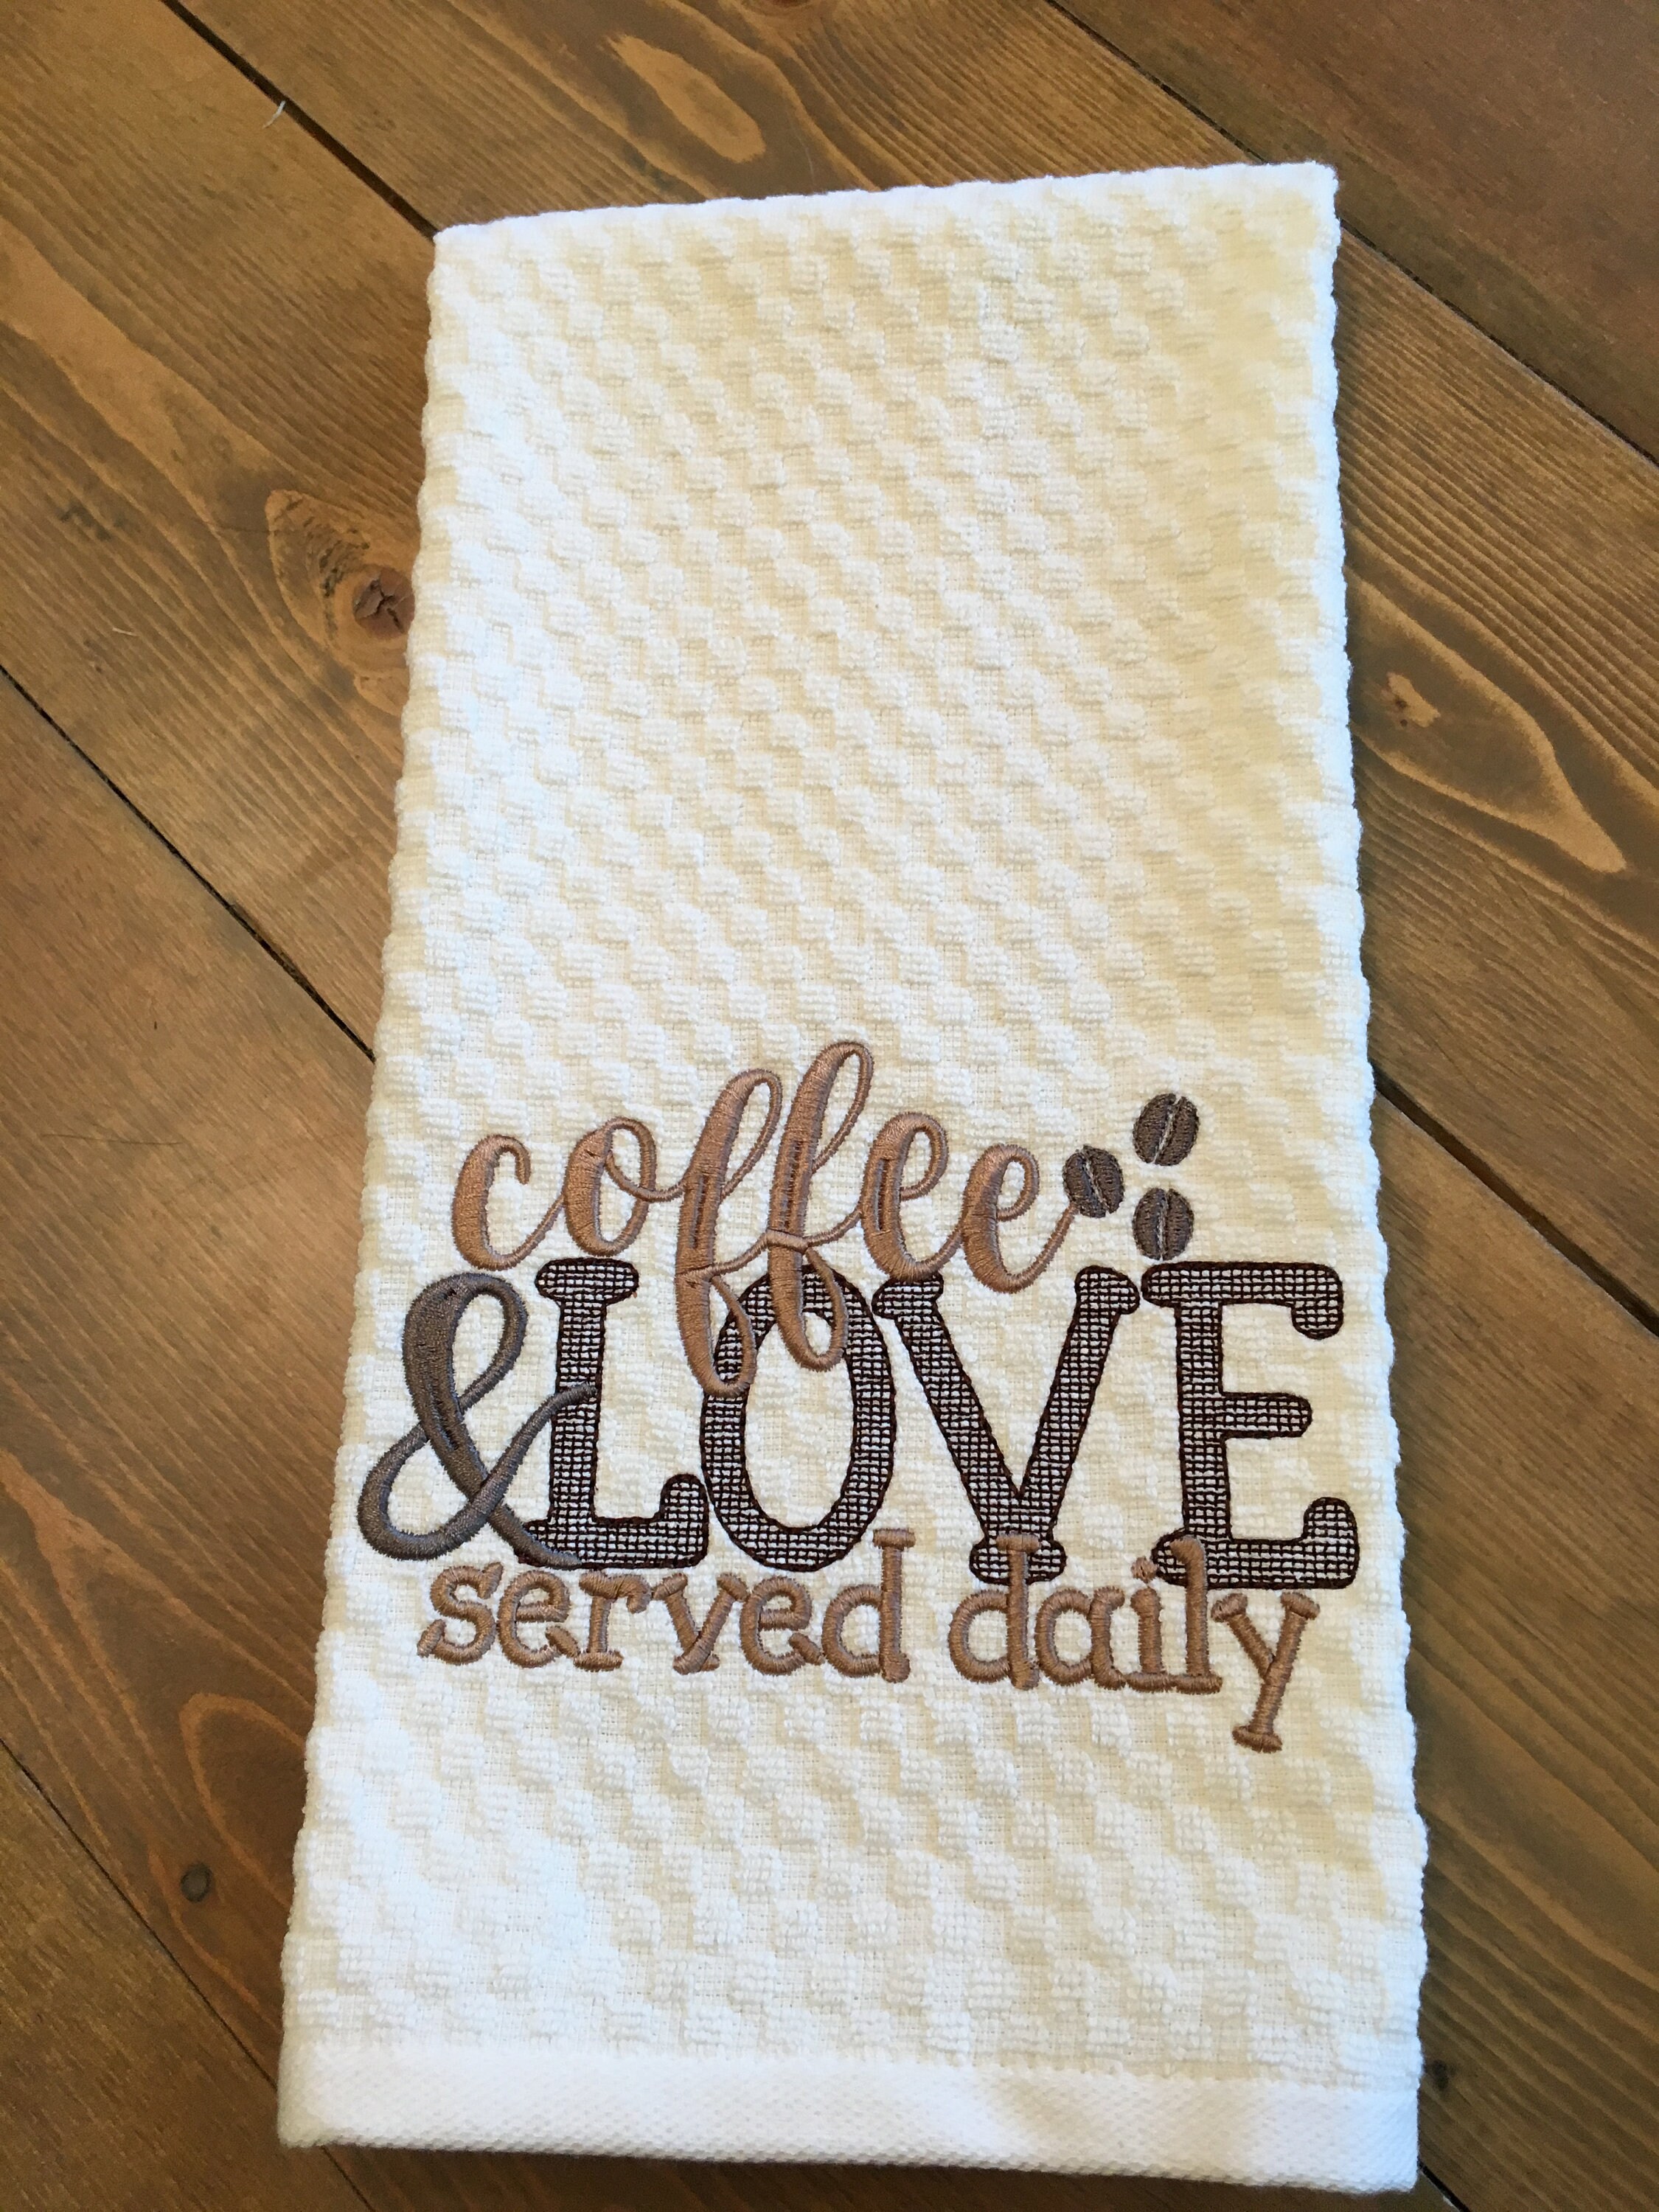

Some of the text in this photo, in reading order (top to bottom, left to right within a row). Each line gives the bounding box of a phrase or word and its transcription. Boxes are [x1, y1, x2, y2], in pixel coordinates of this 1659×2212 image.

[451, 1040, 1076, 1396] coffee
[356, 1257, 1360, 1589] & LOVE
[417, 1528, 1321, 1753] served daily
